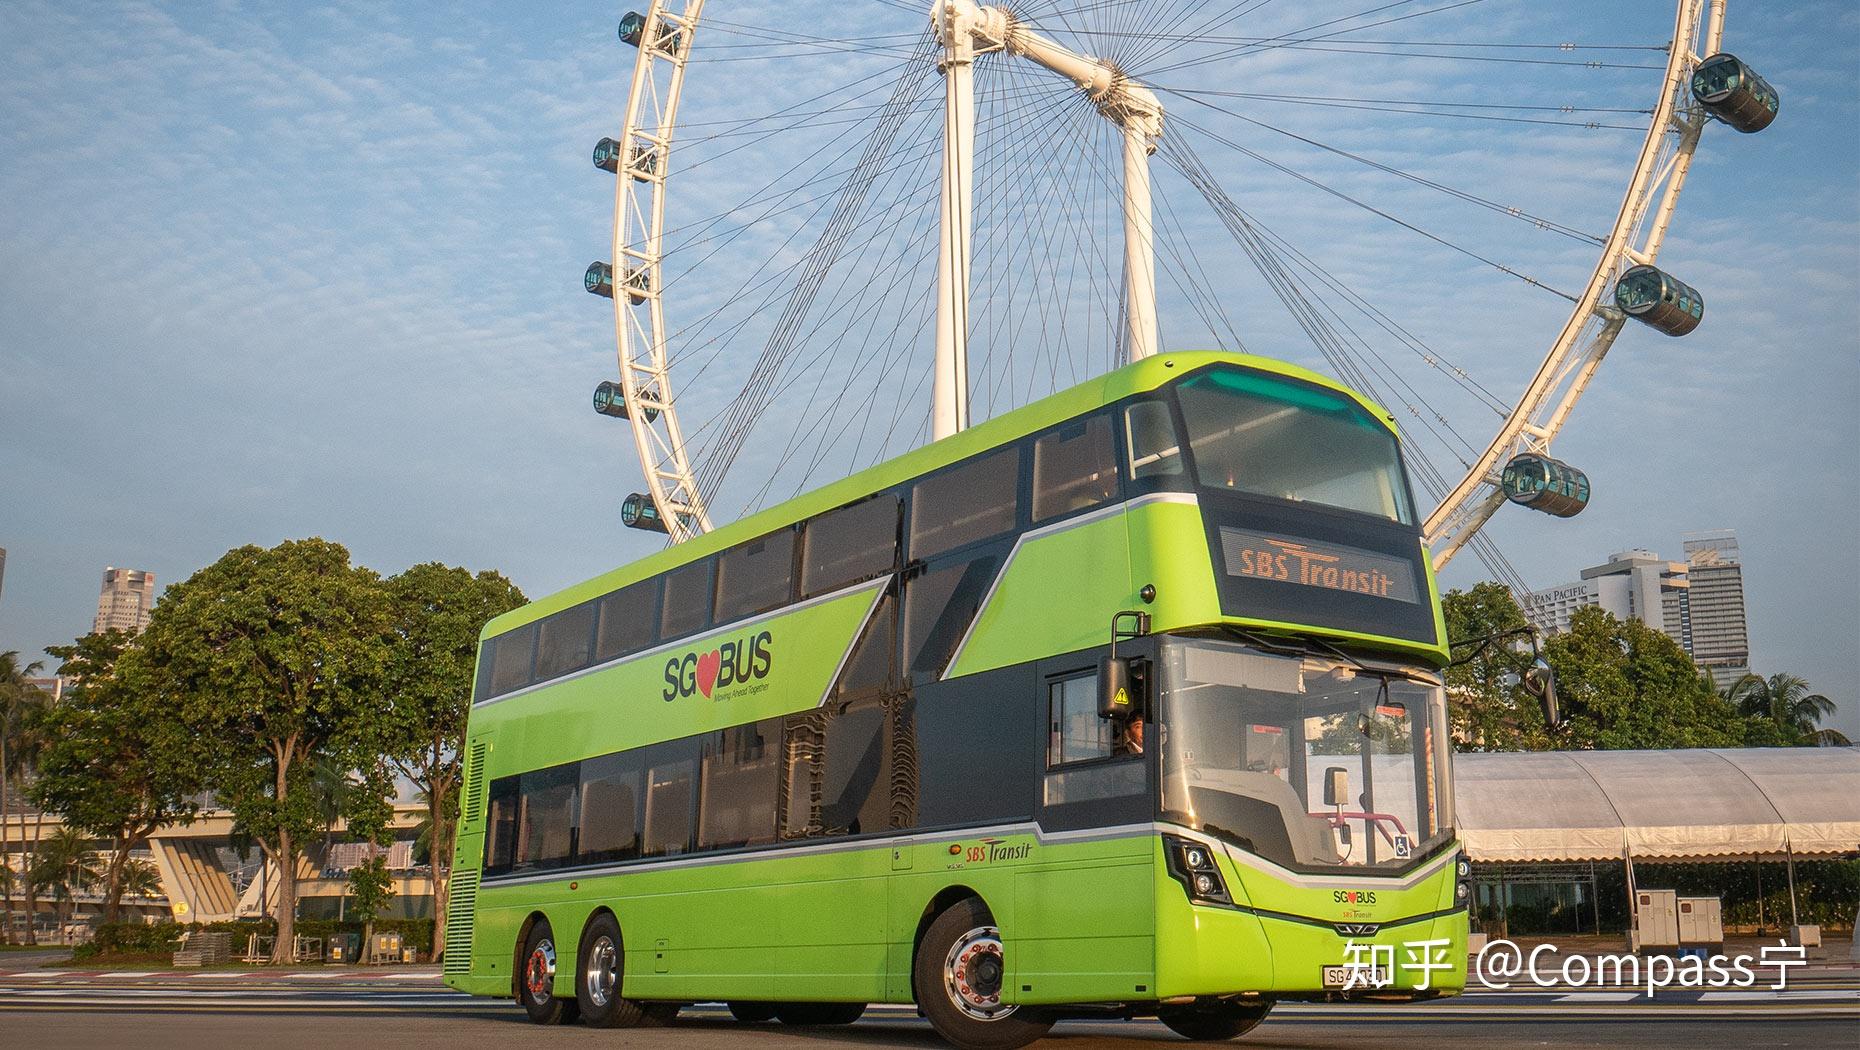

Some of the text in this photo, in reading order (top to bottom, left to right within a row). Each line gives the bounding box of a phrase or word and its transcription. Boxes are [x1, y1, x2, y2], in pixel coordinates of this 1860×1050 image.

[1240, 547, 1394, 596] SBS Transit
[1534, 586, 1587, 604] PAN PACIFIC
[966, 839, 1033, 865] SBS Transit
